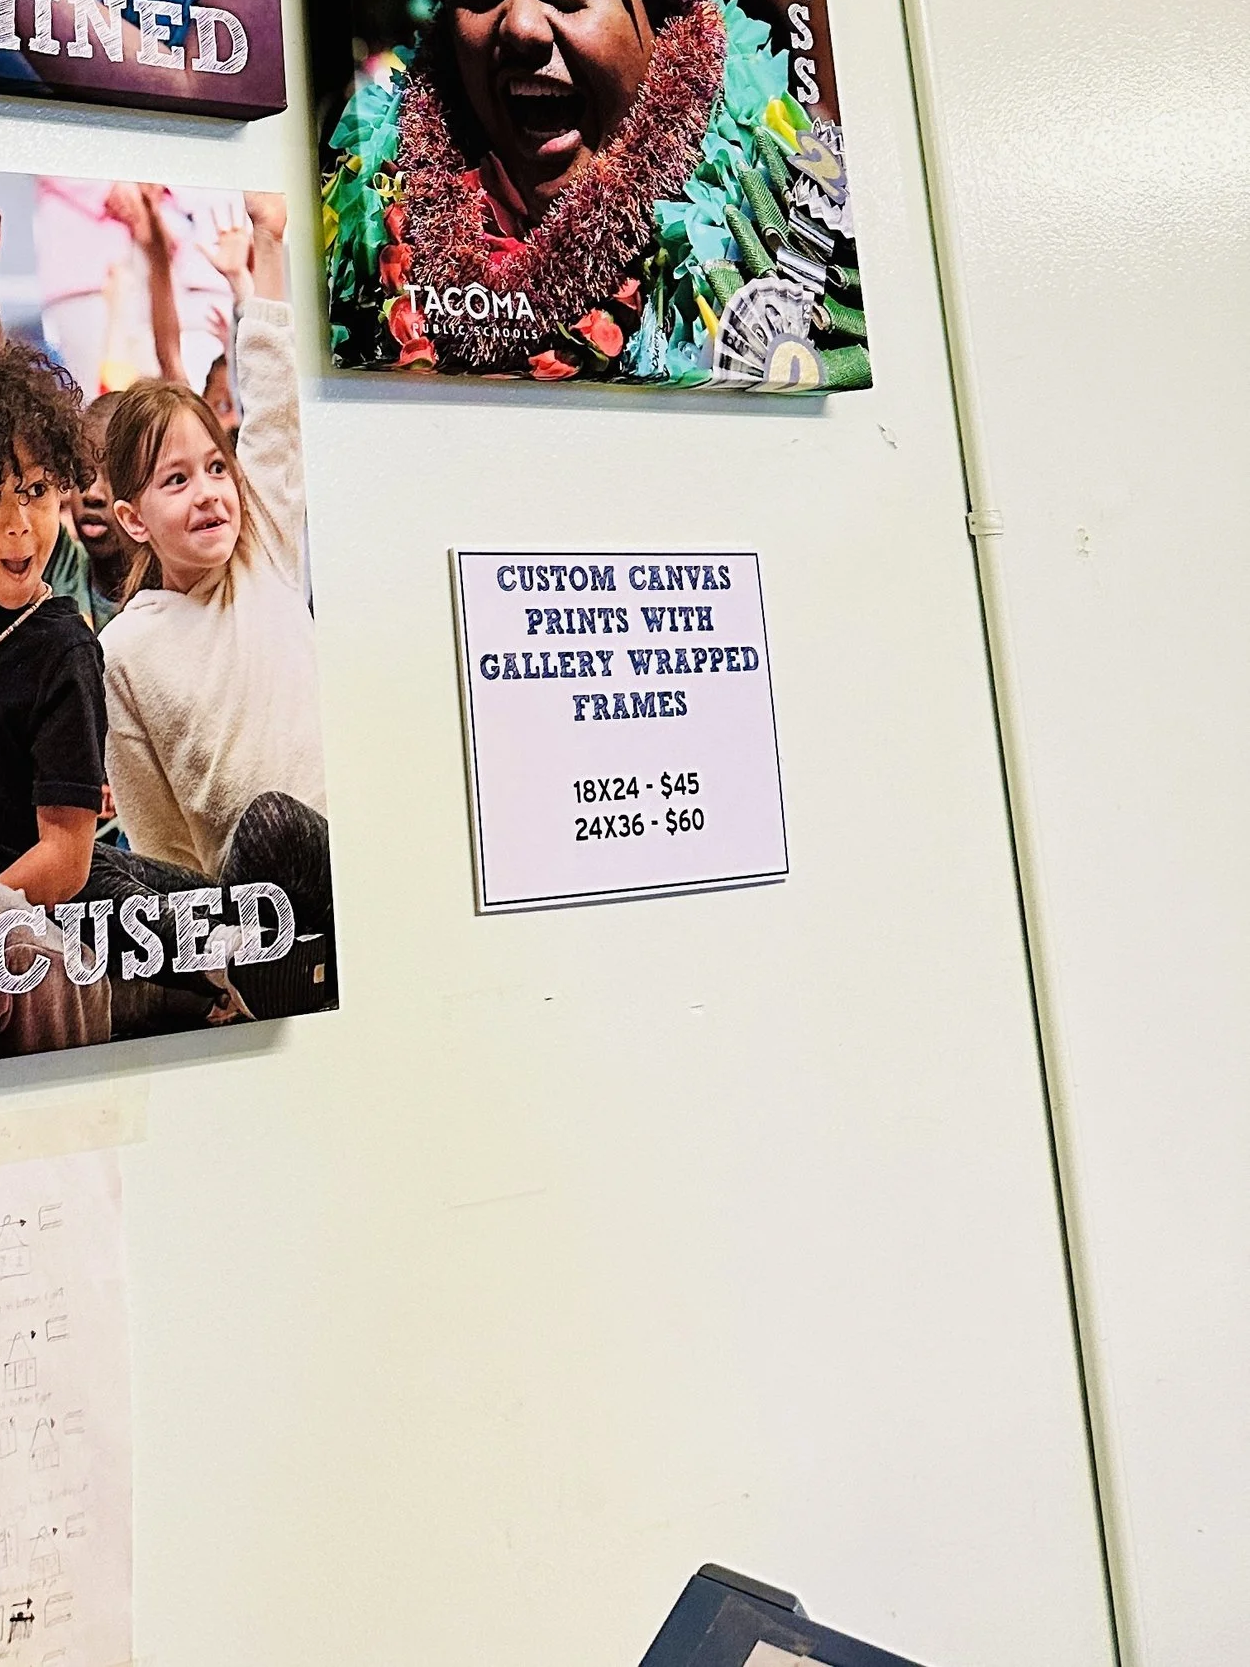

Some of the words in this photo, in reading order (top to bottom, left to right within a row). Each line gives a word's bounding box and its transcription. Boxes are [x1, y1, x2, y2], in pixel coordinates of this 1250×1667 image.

[411, 323, 466, 336] PUBLIC
[474, 325, 539, 340] SCHOOLS
[496, 564, 617, 592] CUSTOM
[628, 565, 732, 591] CANVAS
[525, 607, 629, 635] PRINTS
[640, 606, 714, 632] WITH
[480, 649, 614, 681] GALLERY
[627, 646, 760, 676] WRAPPED
[572, 690, 688, 721] FRAMES
[573, 776, 640, 804] 18X24
[661, 771, 700, 800] $45
[575, 812, 645, 842] 24X36
[665, 807, 705, 836] $60
